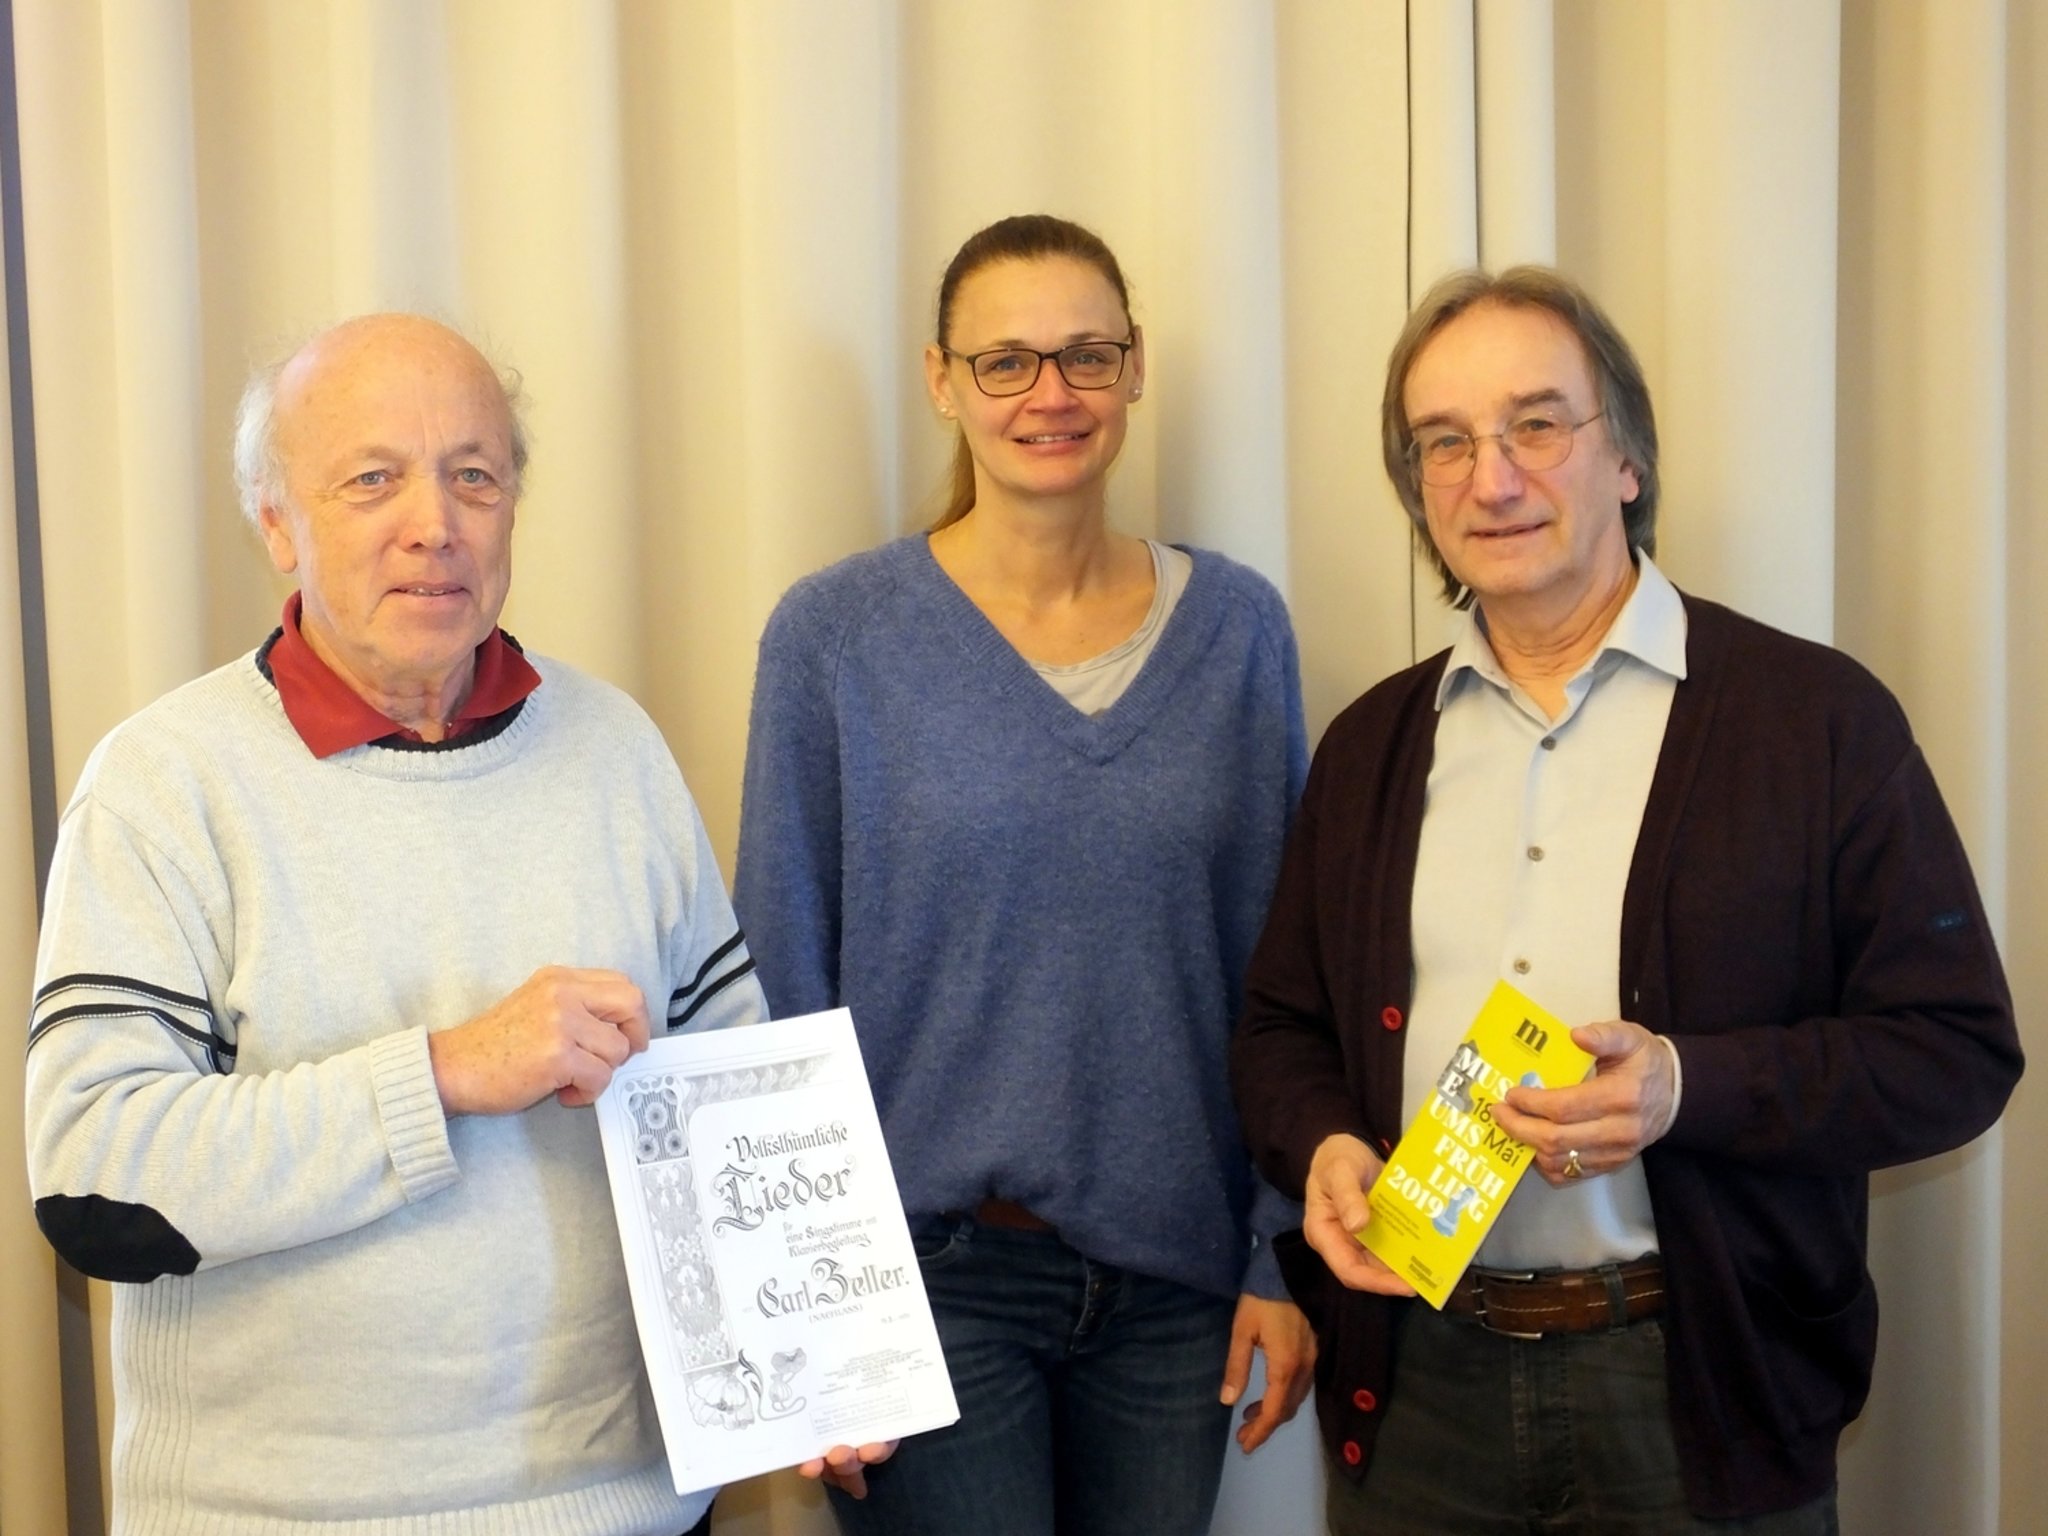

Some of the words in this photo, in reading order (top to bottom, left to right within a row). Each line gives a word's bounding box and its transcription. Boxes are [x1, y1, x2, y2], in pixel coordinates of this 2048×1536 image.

[1515, 1017, 1549, 1053] m
[1441, 1071, 1464, 1098] E
[1456, 1047, 1513, 1102] MUS
[1431, 1095, 1485, 1149] UMS
[1434, 1134, 1506, 1201] FRÜH
[1483, 1128, 1521, 1168] Mai
[711, 1155, 856, 1238] Lieder
[1385, 1164, 1446, 1219] 2019
[786, 1231, 804, 1244] eine
[756, 1276, 813, 1319] Carl
